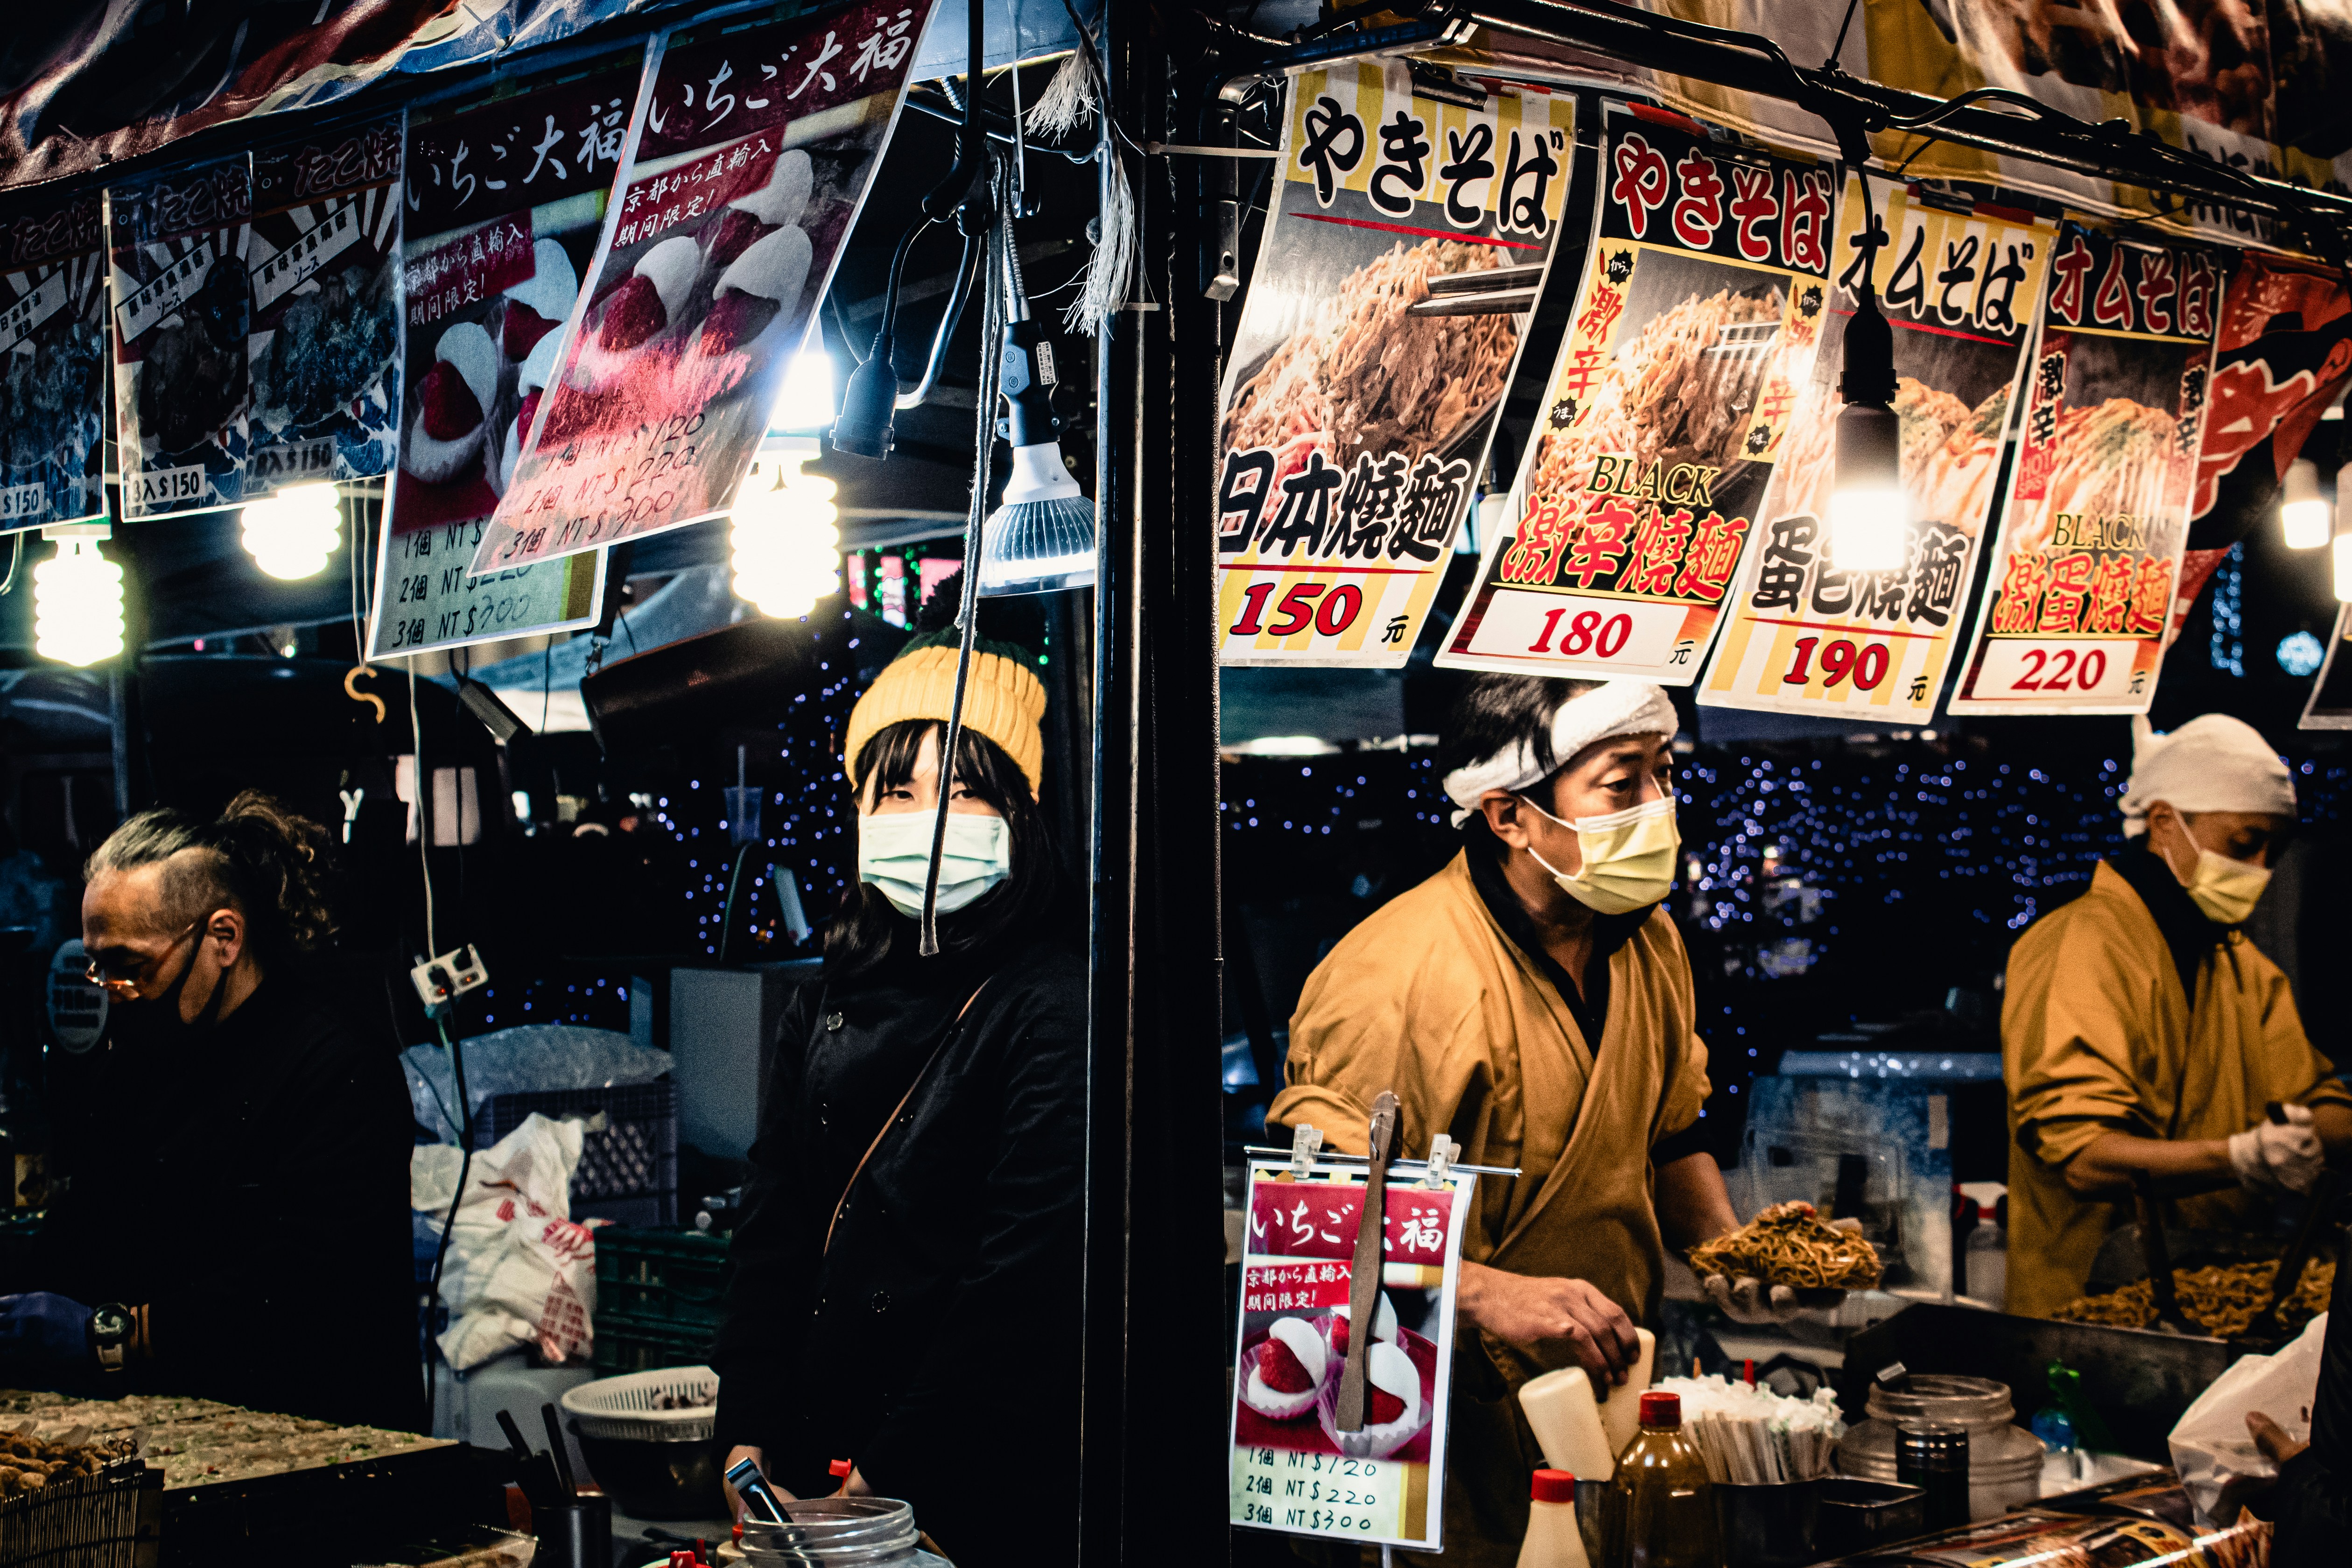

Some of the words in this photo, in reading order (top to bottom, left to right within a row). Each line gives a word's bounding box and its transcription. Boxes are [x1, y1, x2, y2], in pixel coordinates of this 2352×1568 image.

[649, 9, 912, 133] いちご大福
[407, 98, 628, 211] いちご大福
[1299, 96, 1564, 235] やきそば
[625, 139, 771, 213] 京都から直輸入
[1613, 132, 1832, 273] やきそば
[294, 255, 320, 282] ソース
[1838, 214, 2034, 336] オムそば
[2050, 234, 2217, 338] オムそば
[157, 291, 182, 317] ソース
[1586, 456, 1721, 507] BLACK
[524, 485, 563, 514] 2個
[1219, 451, 1470, 562] 日本燒麵
[406, 530, 432, 559] 1個
[504, 527, 546, 559] 3個
[1501, 493, 1749, 599] 激辛燒麵
[2051, 513, 2148, 550] BLACK
[400, 575, 427, 603] 2個
[1229, 583, 1362, 636] 150
[392, 618, 425, 647] 3個
[1381, 615, 1409, 643] 元
[1528, 608, 1632, 659] 180
[1669, 640, 1694, 665] 元
[1783, 637, 1889, 691] 190
[2011, 649, 2107, 692] 220
[2127, 670, 2145, 695] 元
[1907, 675, 1928, 701] 元
[1247, 1265, 1352, 1288] 京都から直輸入
[1250, 1447, 1274, 1466] 1個
[1246, 1475, 1272, 1496] 2個
[1244, 1503, 1272, 1525] 3個
